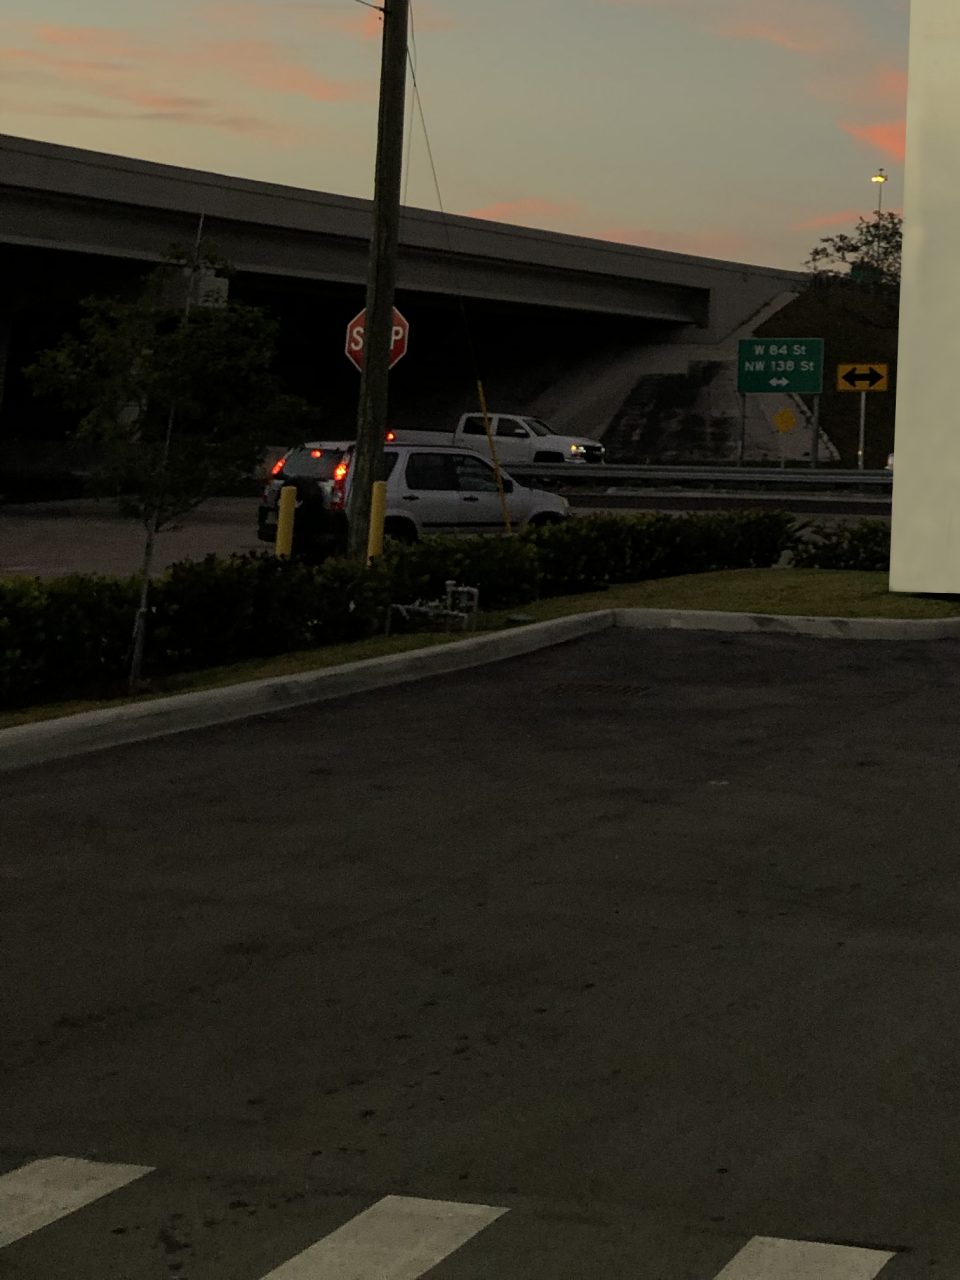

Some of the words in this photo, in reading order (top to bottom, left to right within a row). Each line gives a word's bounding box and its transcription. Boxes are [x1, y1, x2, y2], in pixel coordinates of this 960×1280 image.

[350, 326, 404, 350] SP
[753, 344, 766, 356] W
[793, 344, 807, 356] St
[744, 360, 766, 372] NW
[800, 360, 815, 372] St
